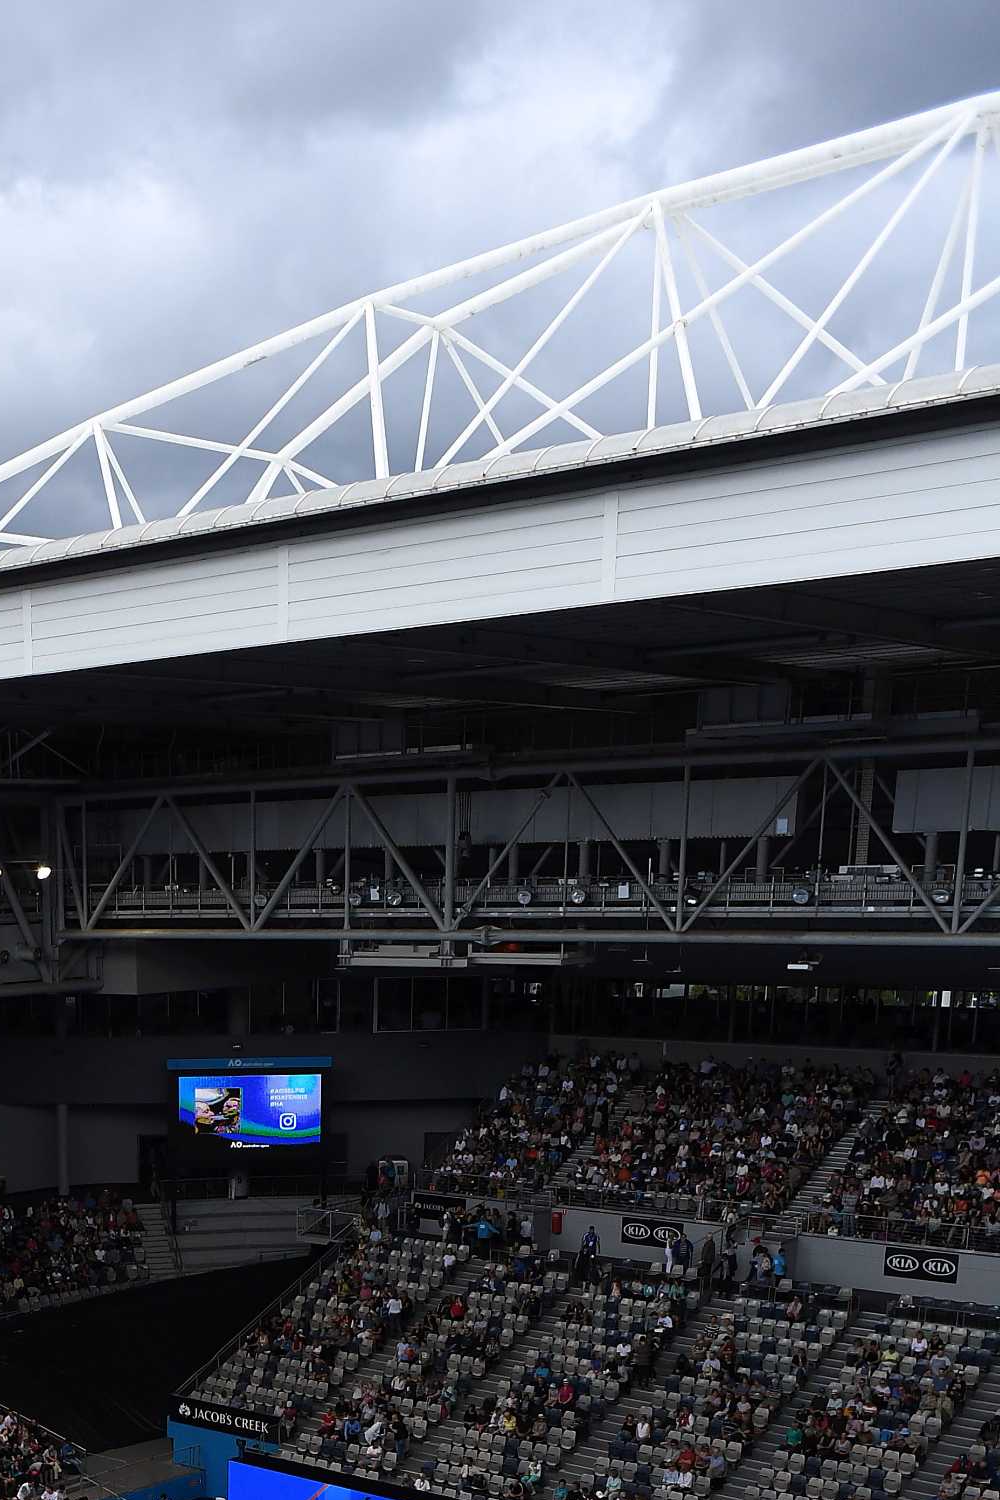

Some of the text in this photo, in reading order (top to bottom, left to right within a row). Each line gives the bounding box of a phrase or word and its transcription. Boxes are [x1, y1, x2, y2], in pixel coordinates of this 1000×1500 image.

[628, 1226, 646, 1236] KIA
[892, 1257, 950, 1273] KIA KIA
[192, 1407, 269, 1434] JACOB'S CREEK
